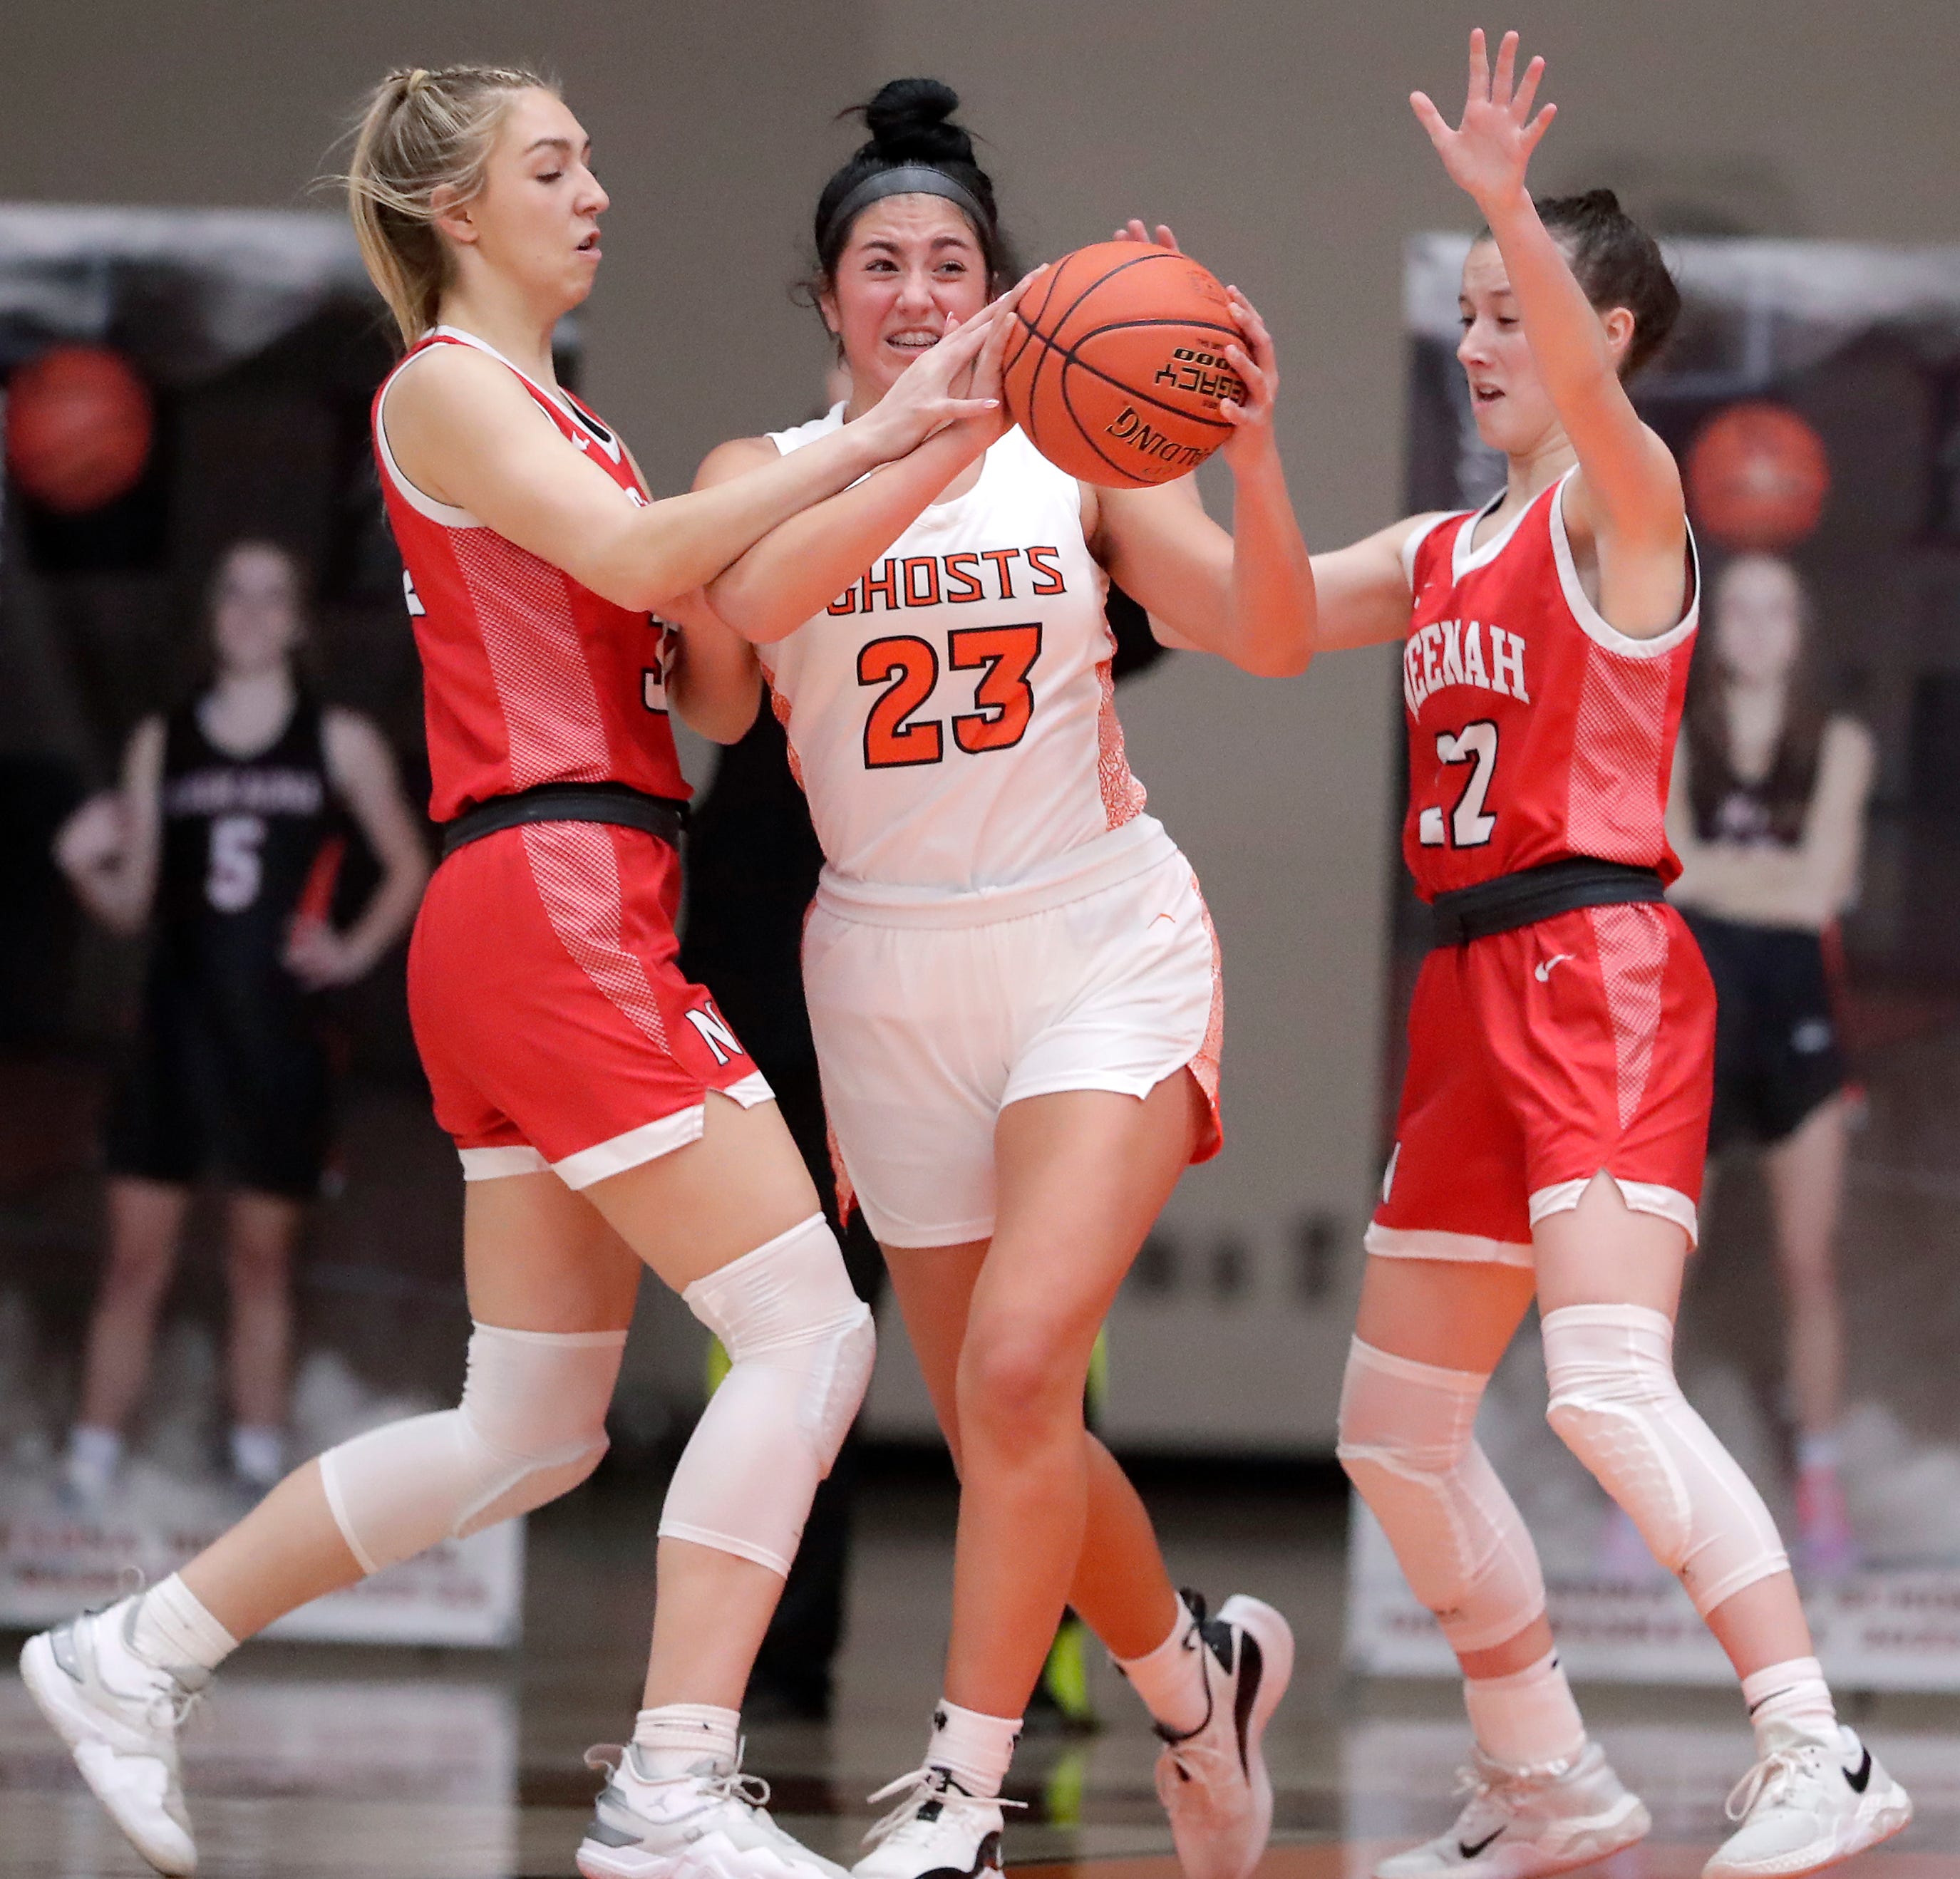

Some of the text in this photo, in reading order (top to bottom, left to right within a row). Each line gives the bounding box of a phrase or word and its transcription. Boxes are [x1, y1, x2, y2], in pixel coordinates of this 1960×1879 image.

[857, 622, 1043, 770] 23
[208, 818, 267, 912] 5
[684, 1000, 744, 1066] N
